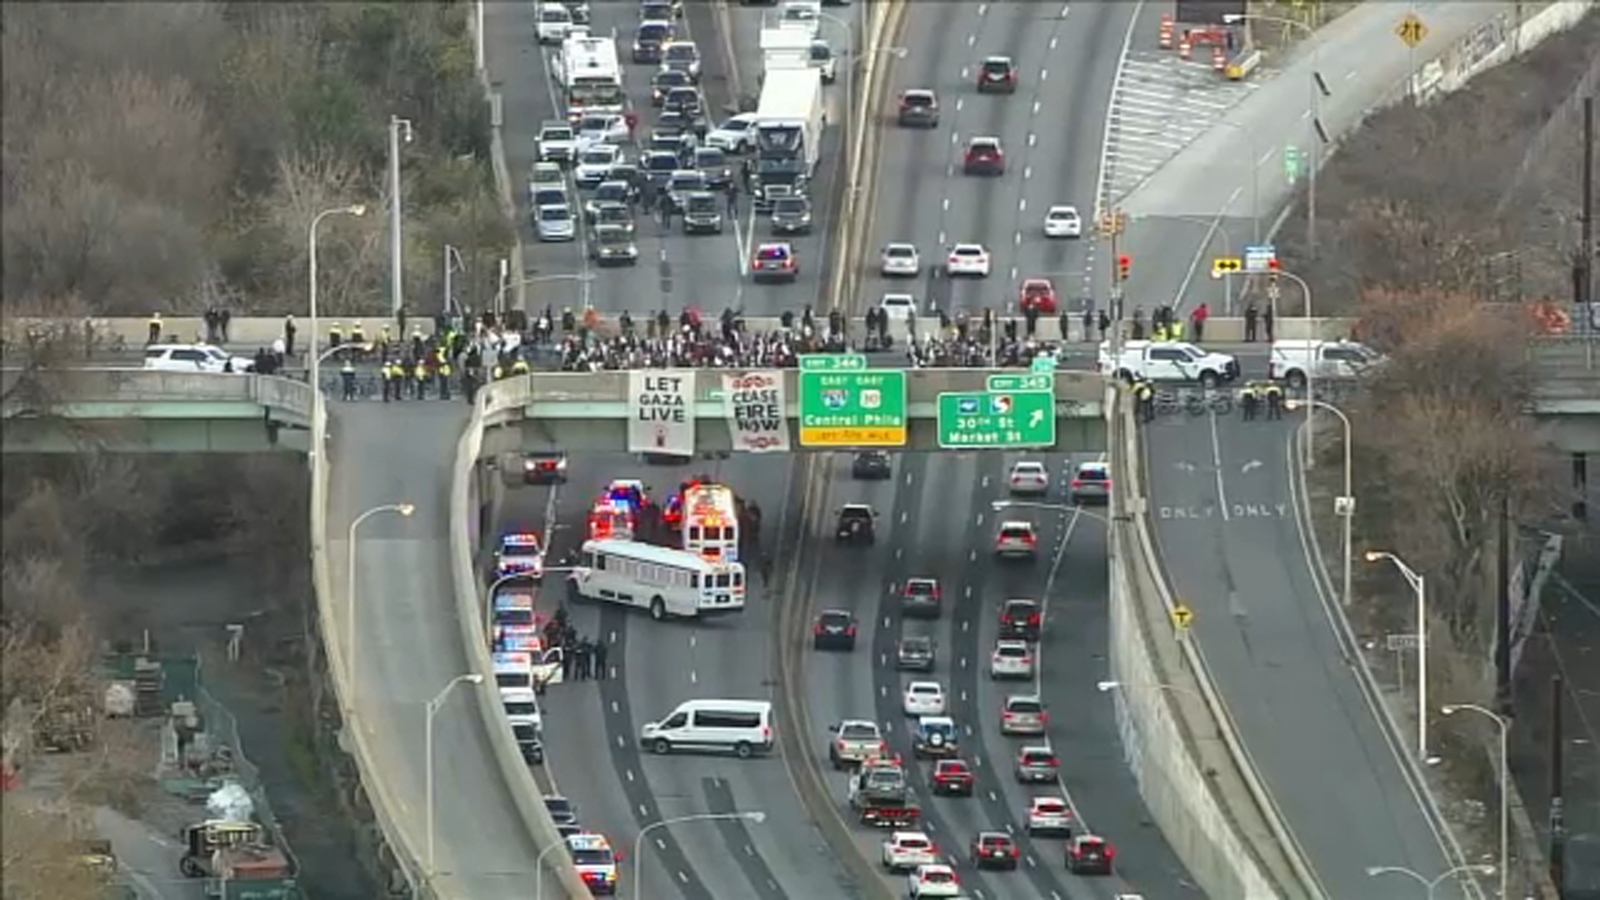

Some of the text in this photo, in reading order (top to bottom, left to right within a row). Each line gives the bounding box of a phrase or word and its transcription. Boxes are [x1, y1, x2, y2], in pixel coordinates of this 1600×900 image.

[645, 377, 682, 391] LET
[821, 376, 884, 386] EAST EAST
[639, 394, 684, 406] GAZA
[732, 389, 778, 404] CEASE
[639, 407, 685, 422] LIVE
[734, 404, 779, 419] FIRE
[738, 420, 780, 432] NOW
[805, 414, 900, 426] Central Phila
[998, 417, 1015, 429] St
[949, 430, 1021, 443] Market St
[1160, 504, 1285, 518] ONLY ONLY
